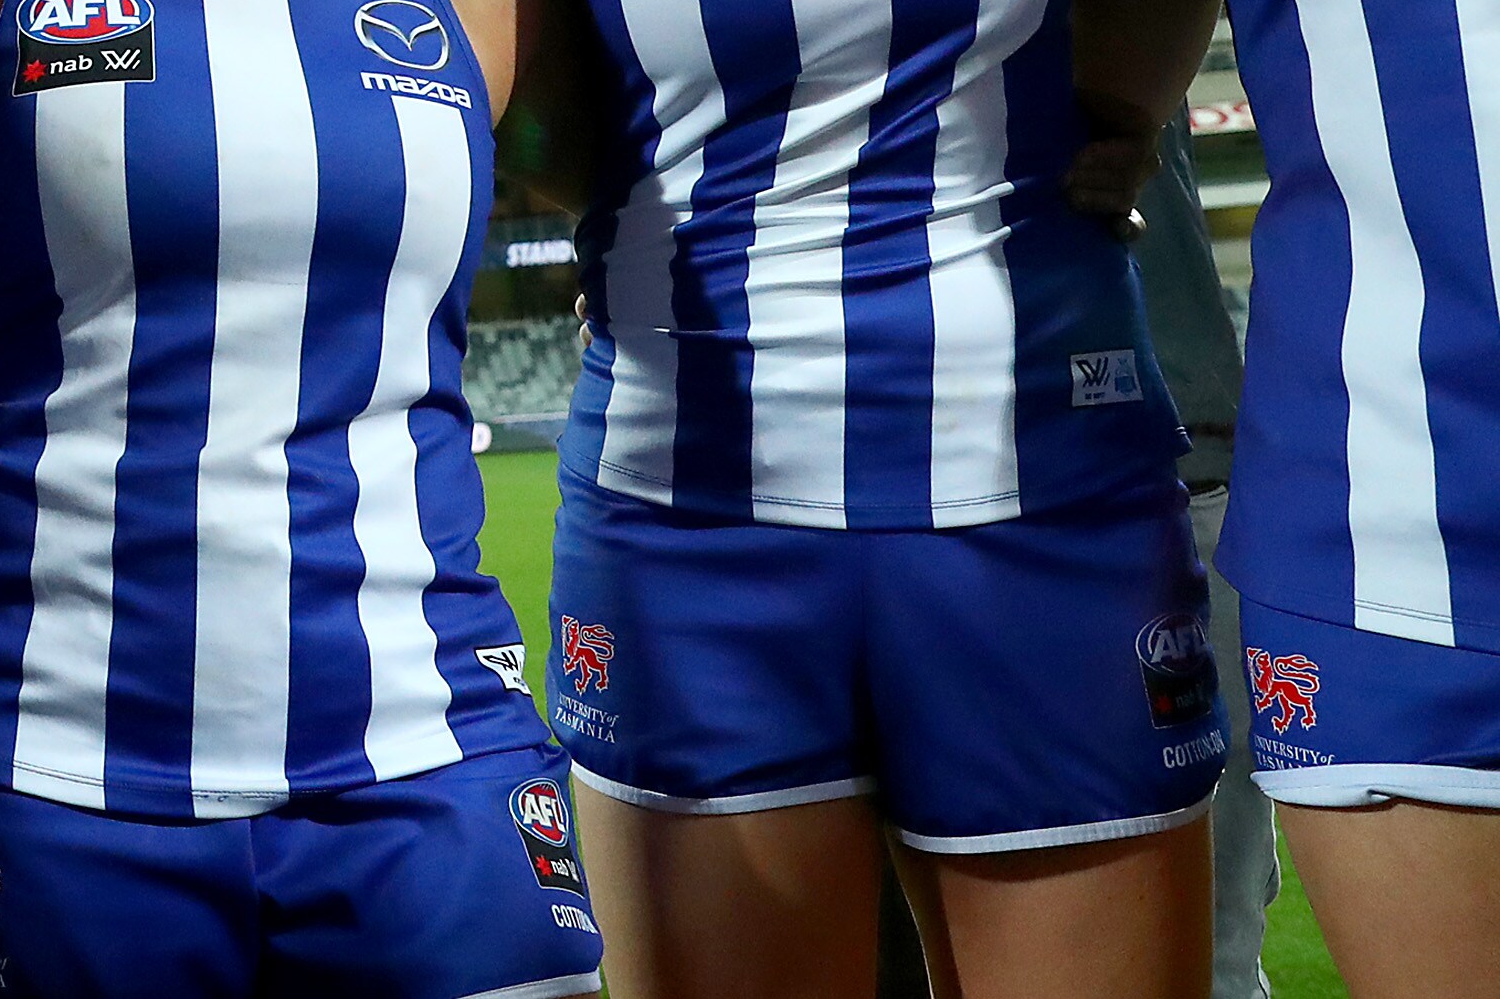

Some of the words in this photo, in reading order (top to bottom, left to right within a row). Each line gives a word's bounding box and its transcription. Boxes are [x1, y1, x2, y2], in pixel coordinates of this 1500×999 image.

[50, 54, 93, 75] nab
[361, 72, 472, 108] mazda
[555, 706, 616, 743] TASMANIA
[523, 792, 566, 833] AFL
